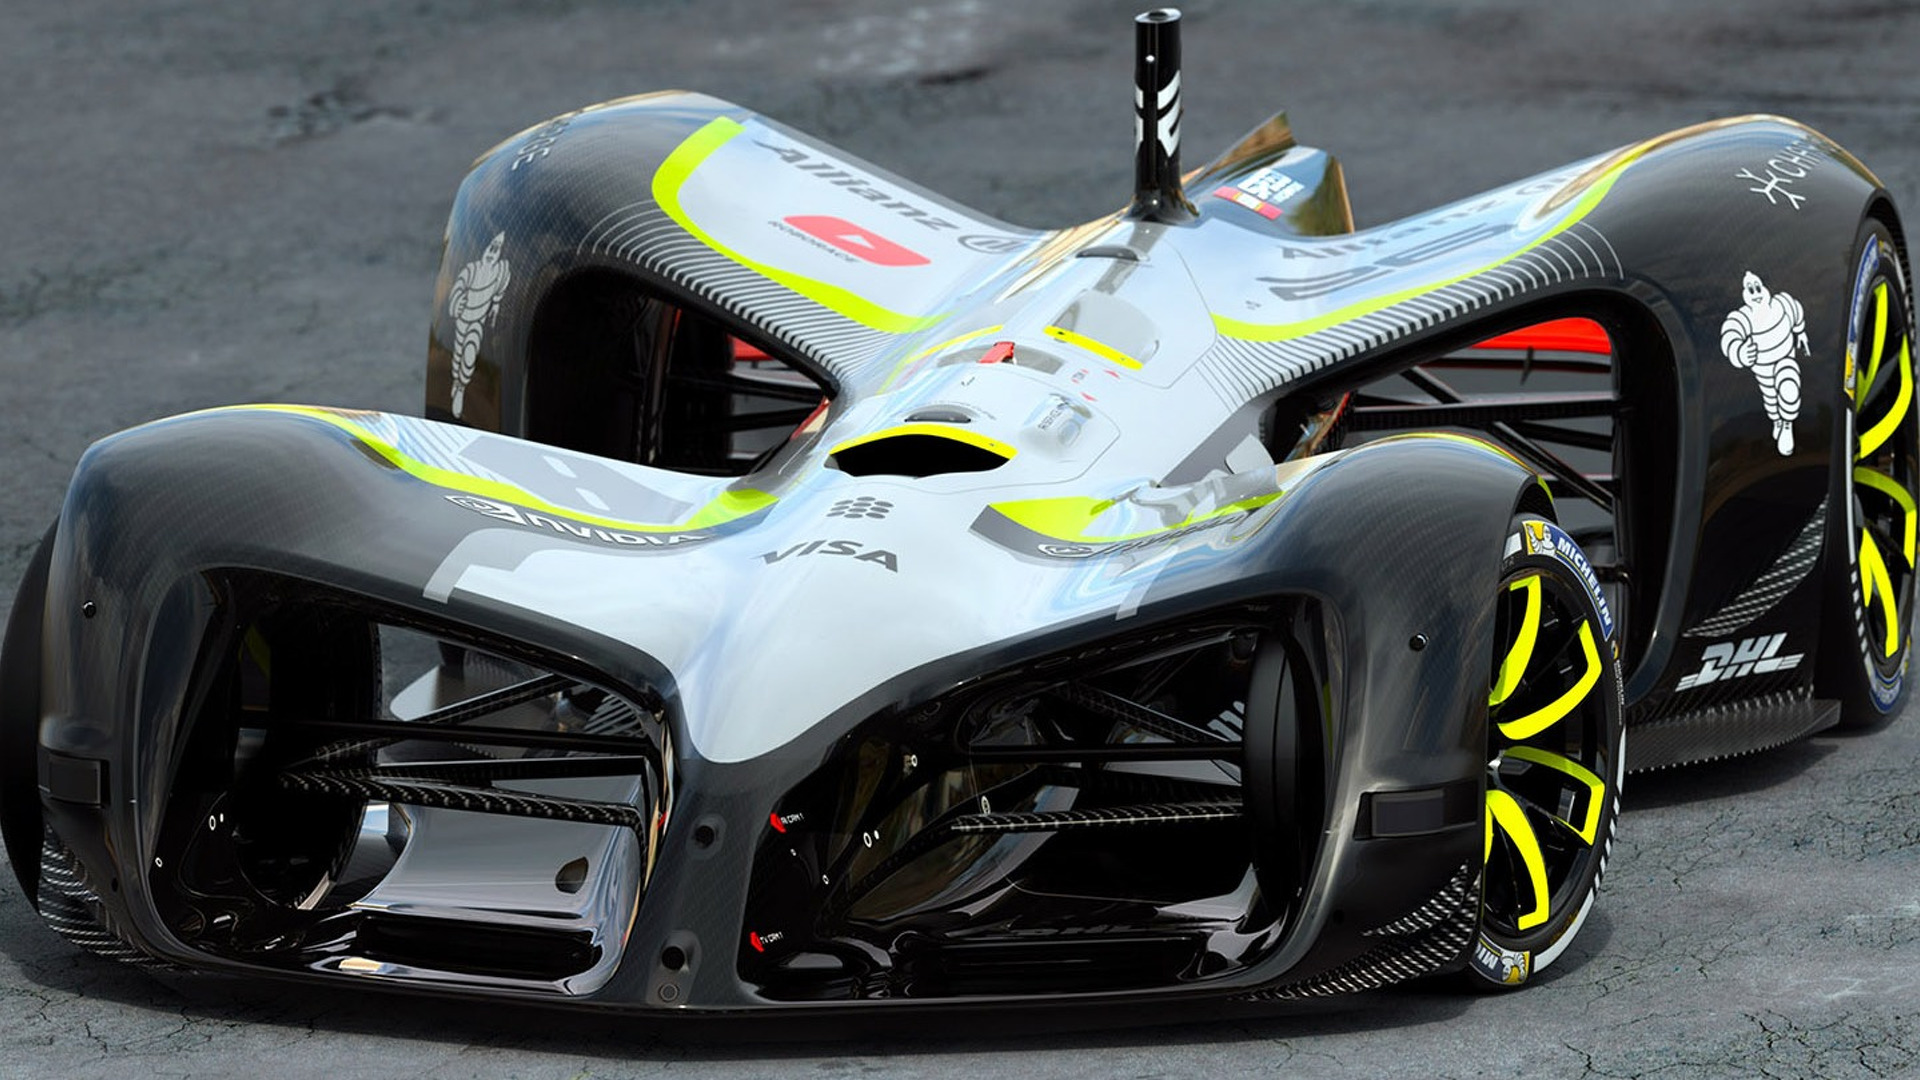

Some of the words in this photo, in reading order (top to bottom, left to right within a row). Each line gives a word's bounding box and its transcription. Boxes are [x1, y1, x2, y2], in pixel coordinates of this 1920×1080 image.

[752, 139, 960, 232] Allianz
[757, 539, 899, 573] VISA
[1556, 537, 1613, 627] MICHELIN
[1693, 632, 1789, 687] DHL
